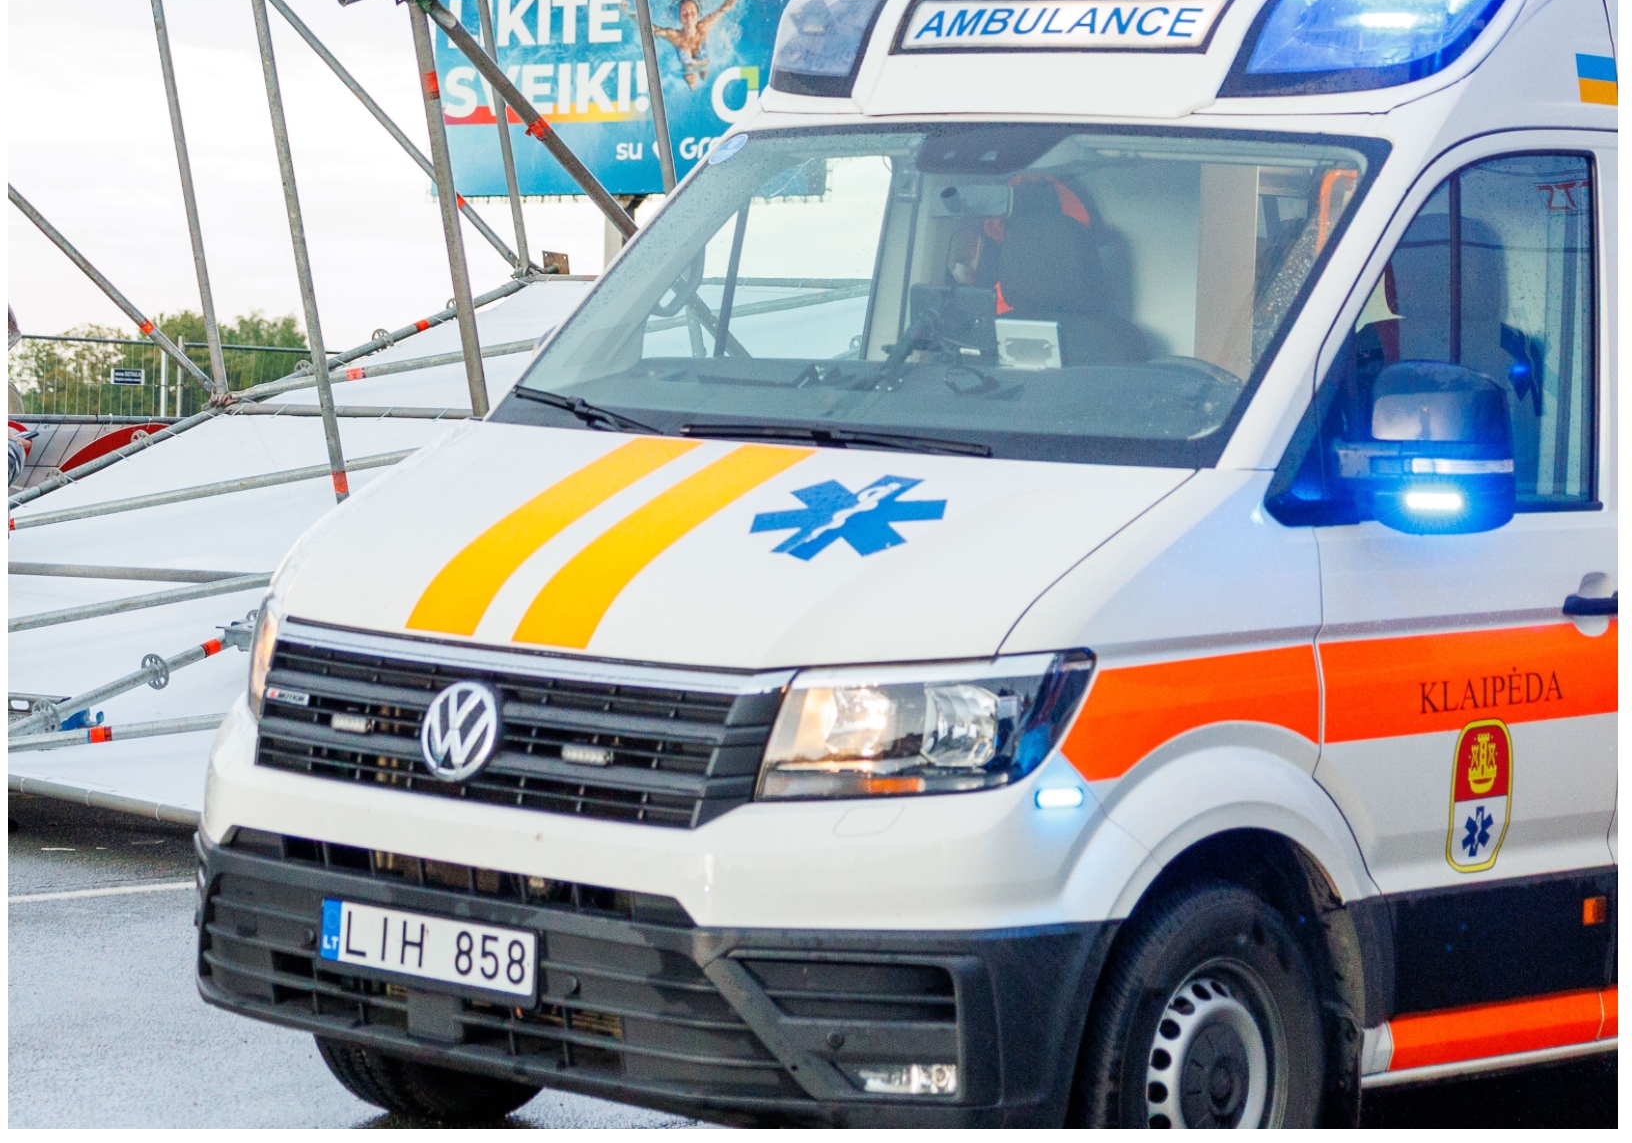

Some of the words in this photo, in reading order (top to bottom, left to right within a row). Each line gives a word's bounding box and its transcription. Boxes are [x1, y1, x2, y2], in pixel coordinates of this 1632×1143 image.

[915, 6, 1203, 40] AMBULANCE
[616, 141, 643, 161] su
[1420, 667, 1564, 715] KLAIPĖDA
[322, 934, 339, 950] LT
[345, 910, 426, 969] LIH
[454, 930, 526, 985] 858
